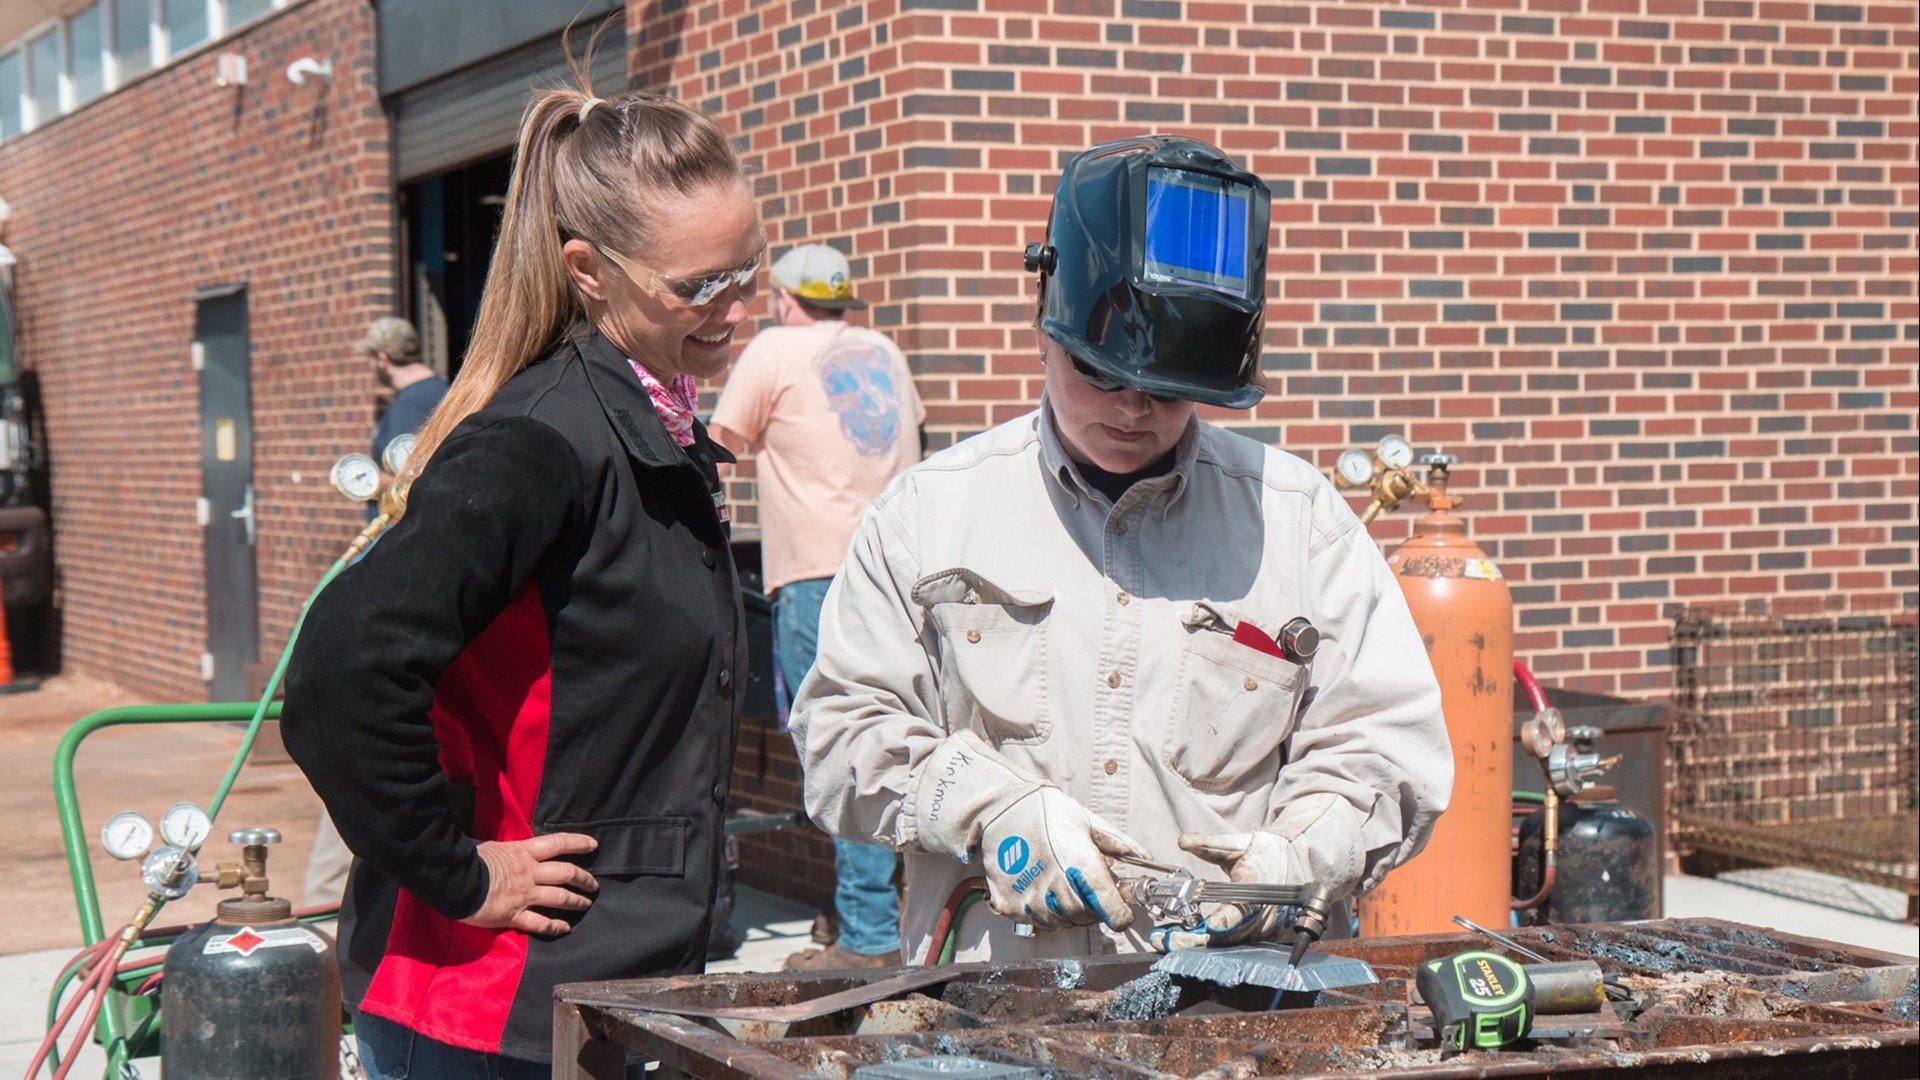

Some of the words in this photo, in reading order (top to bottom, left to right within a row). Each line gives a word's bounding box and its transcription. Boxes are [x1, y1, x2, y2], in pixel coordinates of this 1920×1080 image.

[929, 751, 973, 822] Kirkman
[1011, 859, 1045, 895] Miller
[1476, 959, 1505, 996] STANLEY
